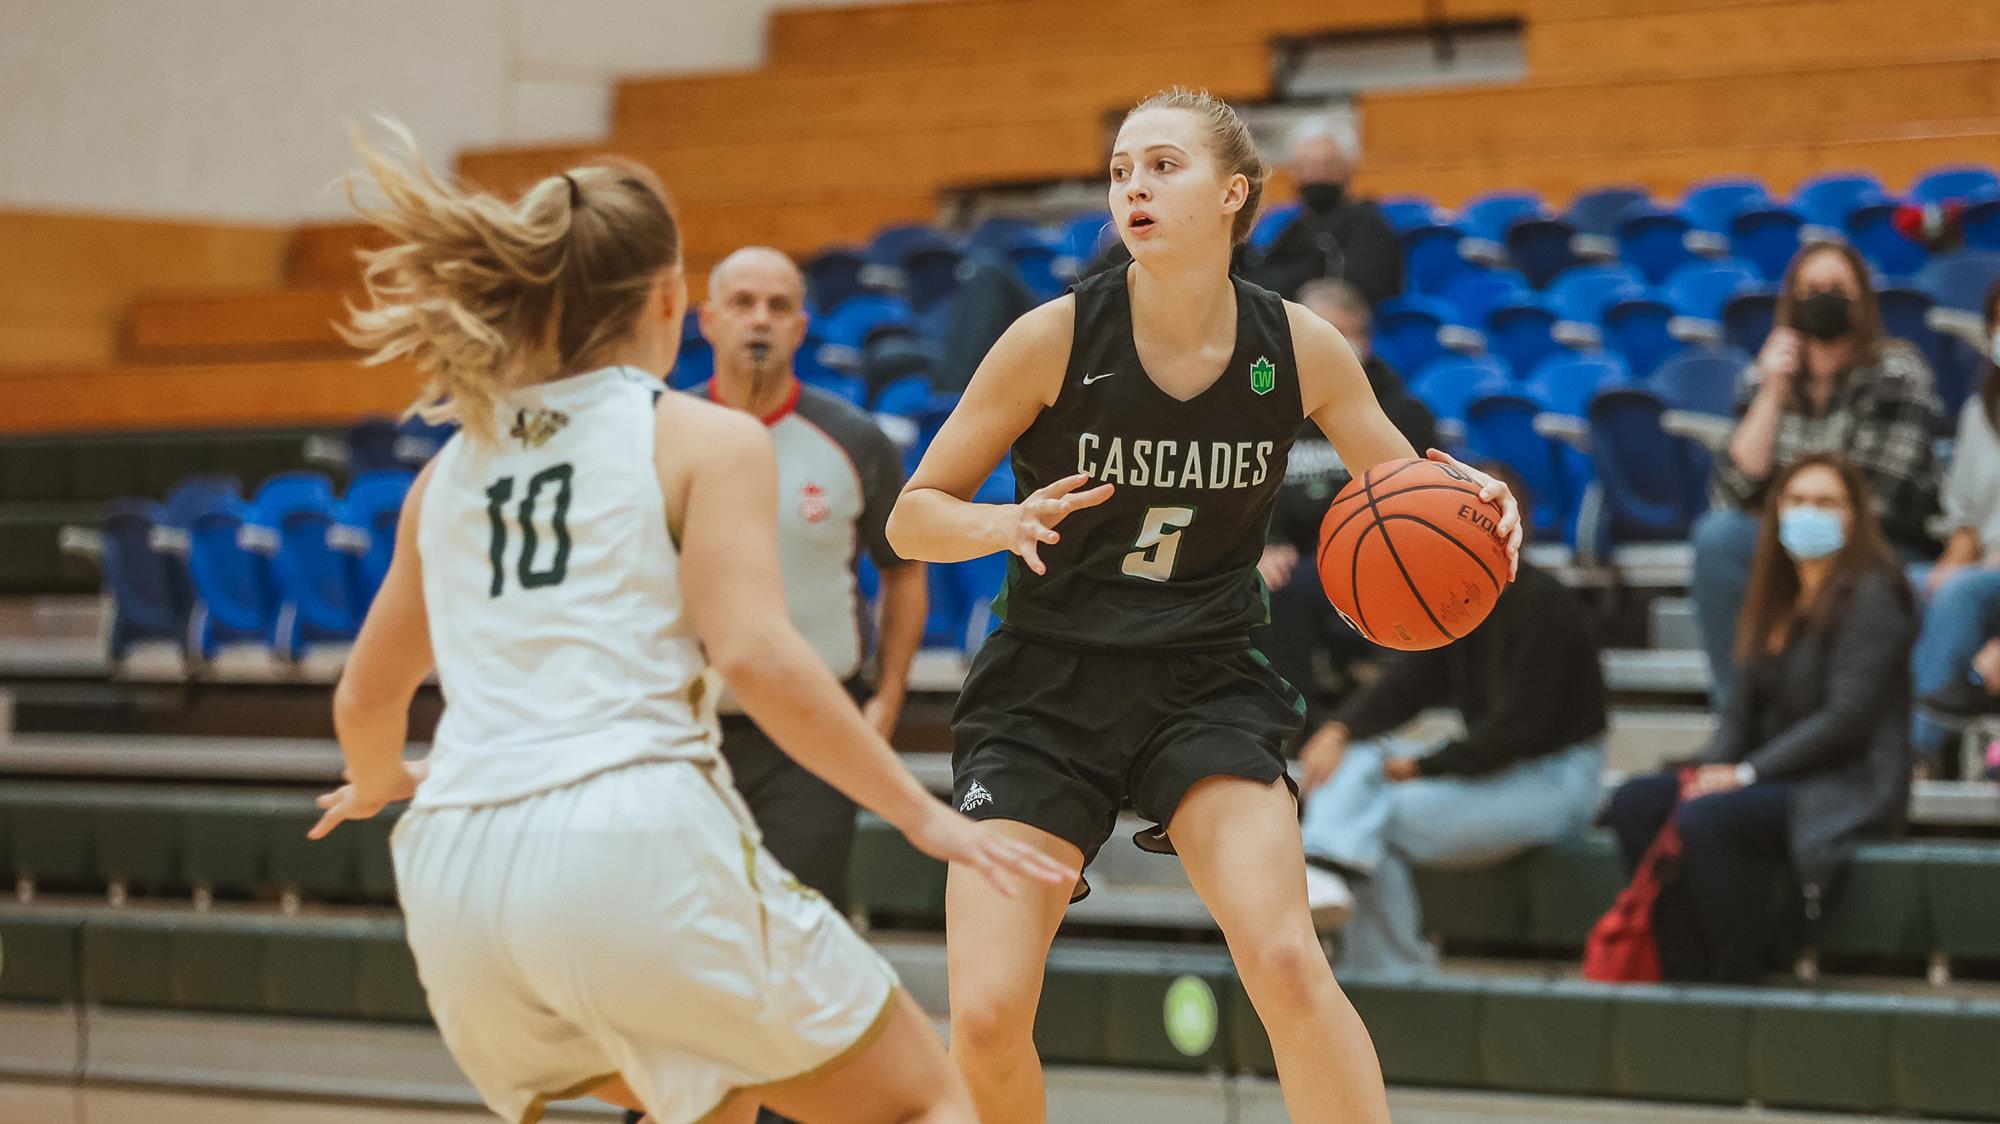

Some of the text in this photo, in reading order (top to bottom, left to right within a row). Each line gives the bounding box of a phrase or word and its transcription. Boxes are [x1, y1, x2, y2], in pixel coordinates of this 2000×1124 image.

[1253, 371, 1271, 388] CW
[1077, 432, 1274, 489] CASCADES
[485, 461, 574, 599] 10
[1121, 506, 1195, 583] 5
[966, 798, 984, 811] UFV
